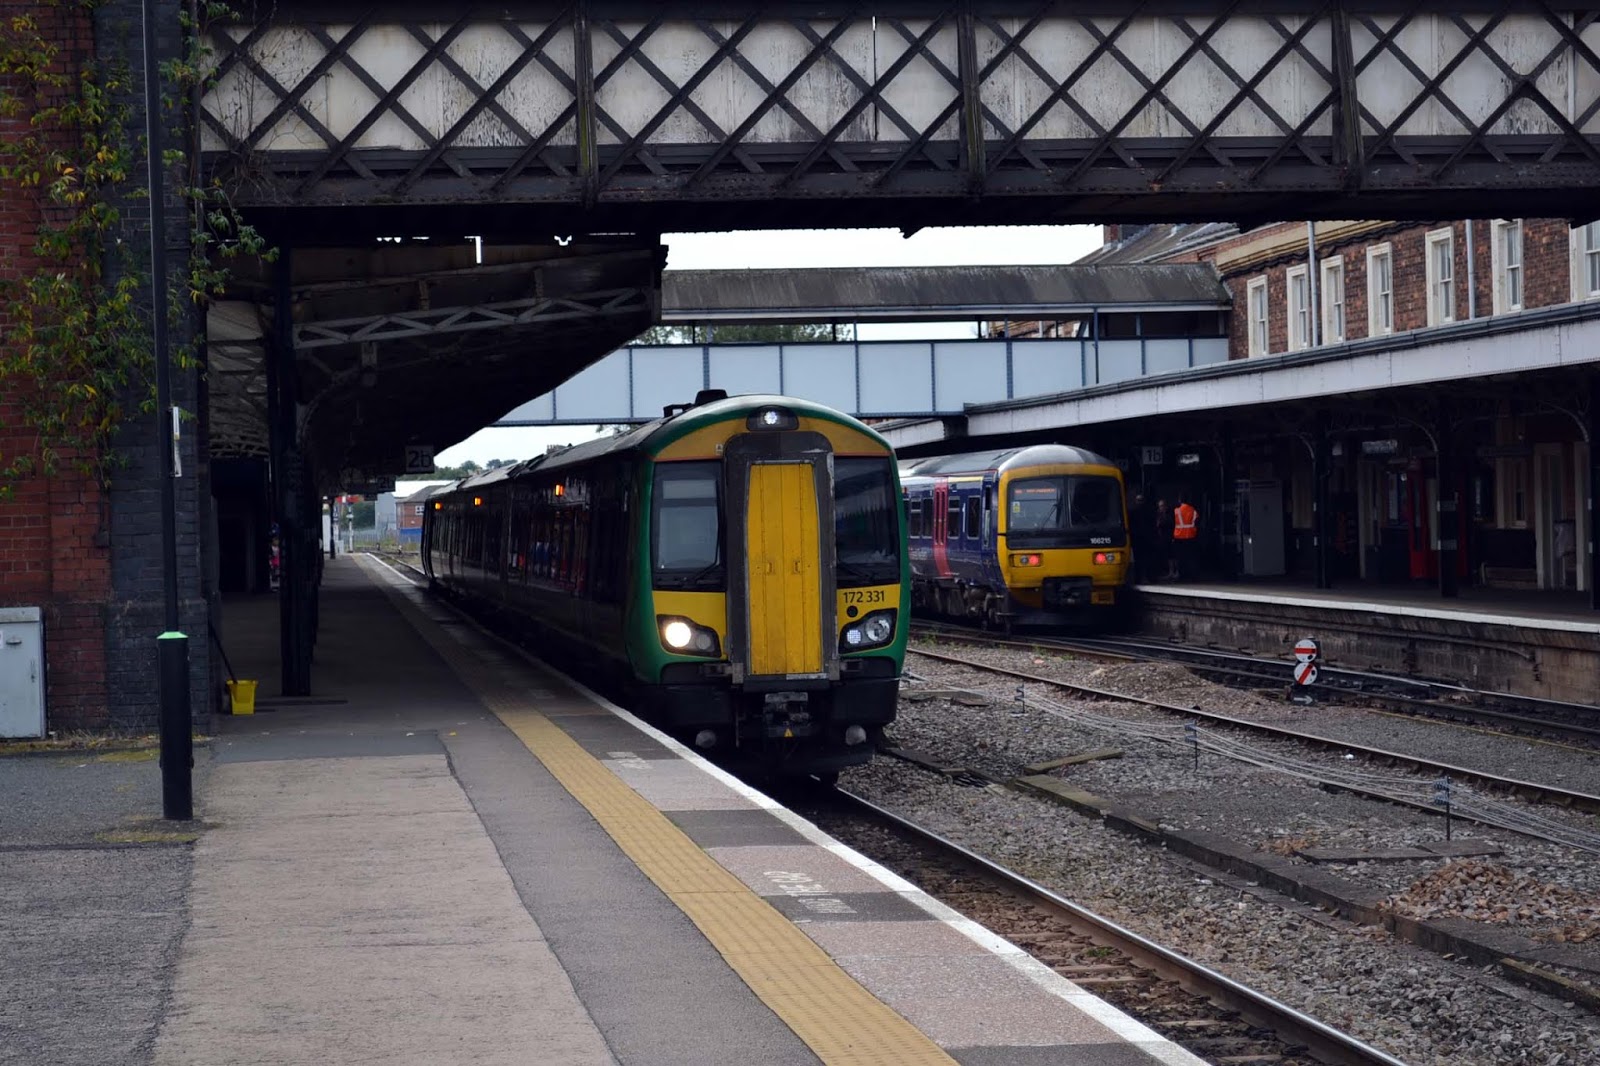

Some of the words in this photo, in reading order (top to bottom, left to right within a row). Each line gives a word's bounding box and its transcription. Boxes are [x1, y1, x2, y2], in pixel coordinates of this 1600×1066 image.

[408, 450, 432, 468] 2b
[1146, 449, 1161, 462] 1b
[1090, 537, 1111, 545] 166215
[843, 591, 864, 603] 172
[865, 590, 885, 603] 331
